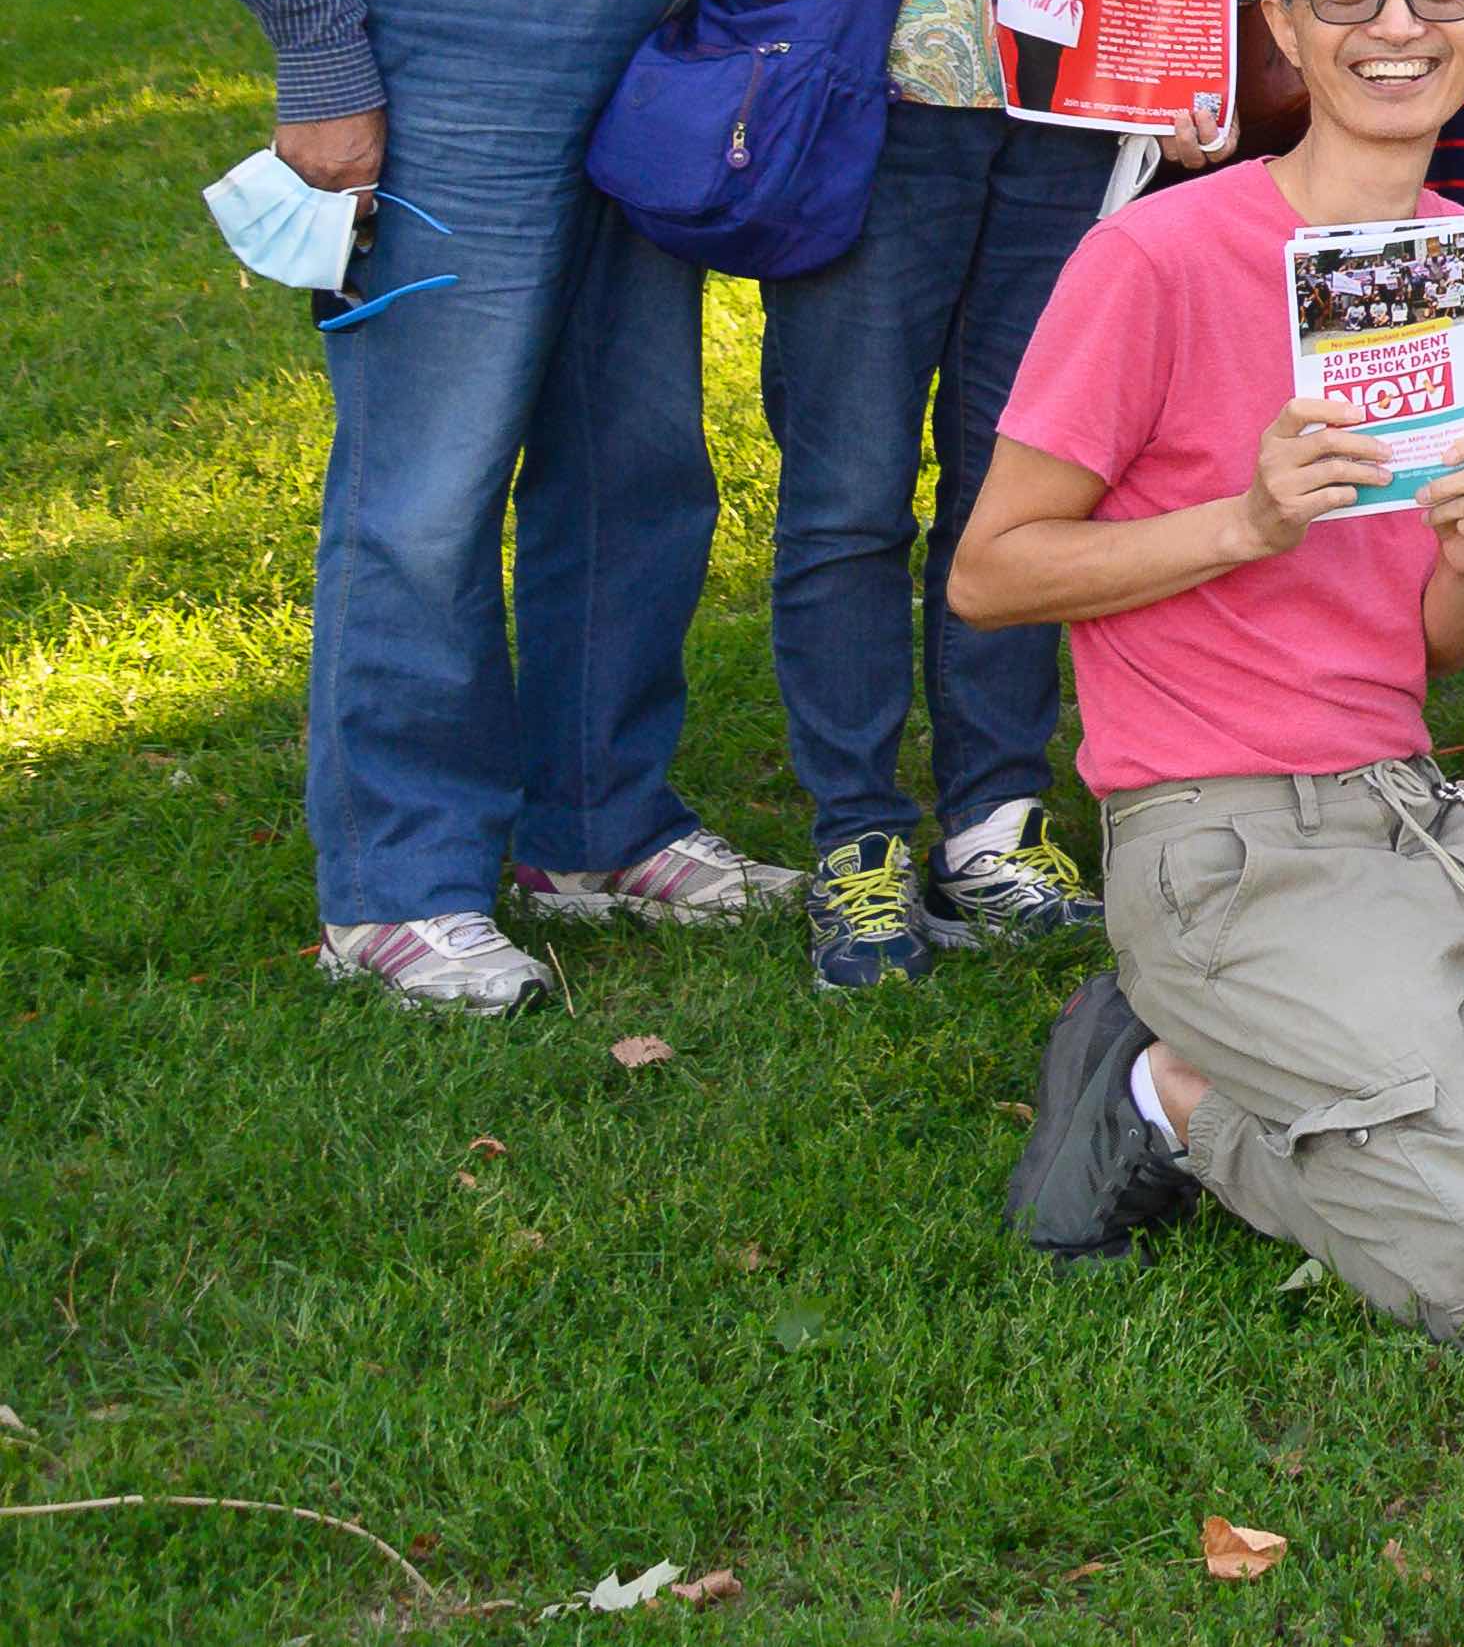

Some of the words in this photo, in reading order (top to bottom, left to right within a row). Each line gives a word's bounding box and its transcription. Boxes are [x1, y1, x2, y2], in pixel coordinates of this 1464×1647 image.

[1323, 354, 1344, 369] 10
[1349, 333, 1449, 365] PERMANENT
[1323, 366, 1362, 383] PAID
[1367, 358, 1405, 376] SICK
[1411, 348, 1450, 367] DAYS
[1328, 366, 1446, 422] NOW
